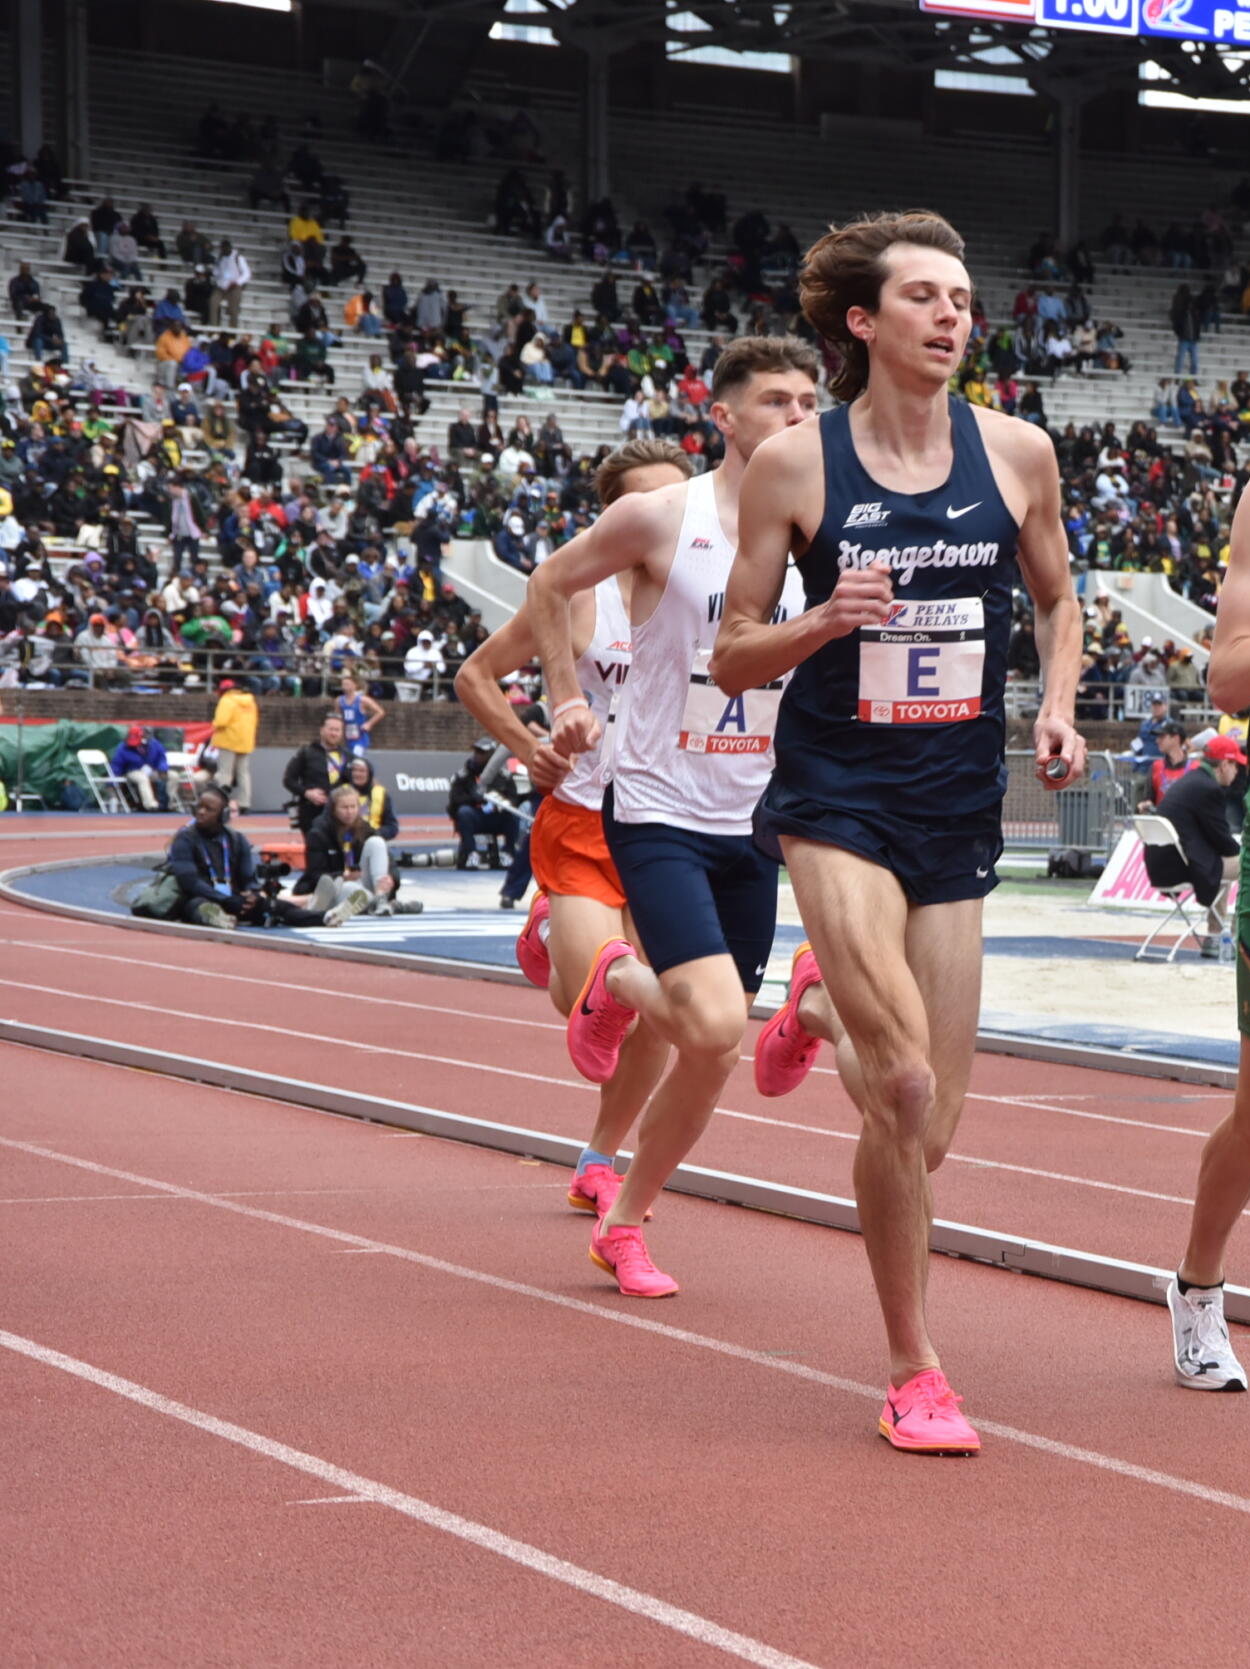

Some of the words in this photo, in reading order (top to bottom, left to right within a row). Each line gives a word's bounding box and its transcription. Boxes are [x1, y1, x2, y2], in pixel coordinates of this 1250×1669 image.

[851, 502, 883, 513] BIG
[846, 510, 892, 523] EAST
[837, 539, 999, 586] Georgetown
[916, 604, 957, 615] PENN
[913, 614, 968, 627] RELAYS
[880, 631, 912, 641] Dream
[907, 648, 940, 697] E
[715, 692, 746, 732] A
[896, 702, 970, 719] TOYOTA
[710, 738, 760, 750] TOYOTA
[395, 772, 451, 792] Dream
